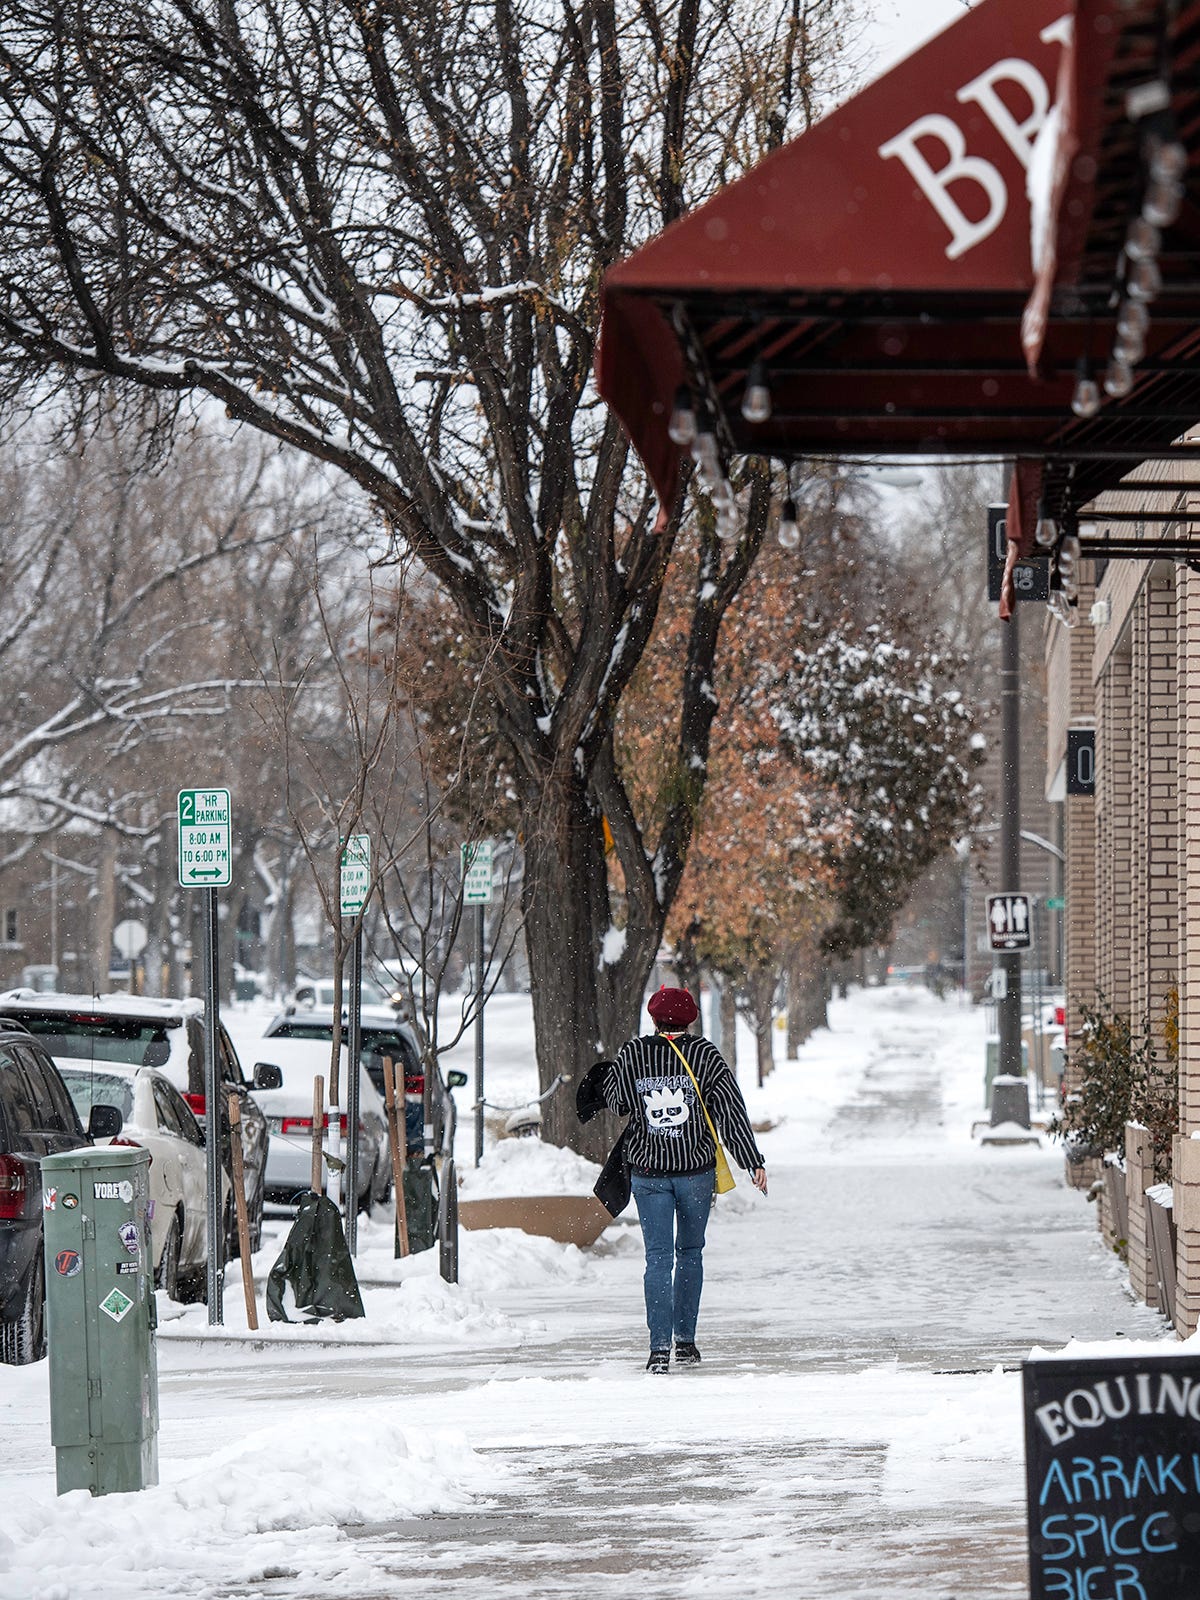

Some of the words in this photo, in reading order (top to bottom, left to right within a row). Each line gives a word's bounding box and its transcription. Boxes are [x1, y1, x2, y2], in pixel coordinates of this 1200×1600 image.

[204, 794, 218, 807] HR
[181, 796, 193, 820] 2
[196, 809, 227, 822] PARKING
[189, 832, 207, 845] 8:00
[209, 832, 221, 844] AM
[183, 850, 193, 863] TO
[195, 849, 214, 862] 6:00
[216, 849, 227, 862] PM
[1041, 1511, 1179, 1561] SPICE
